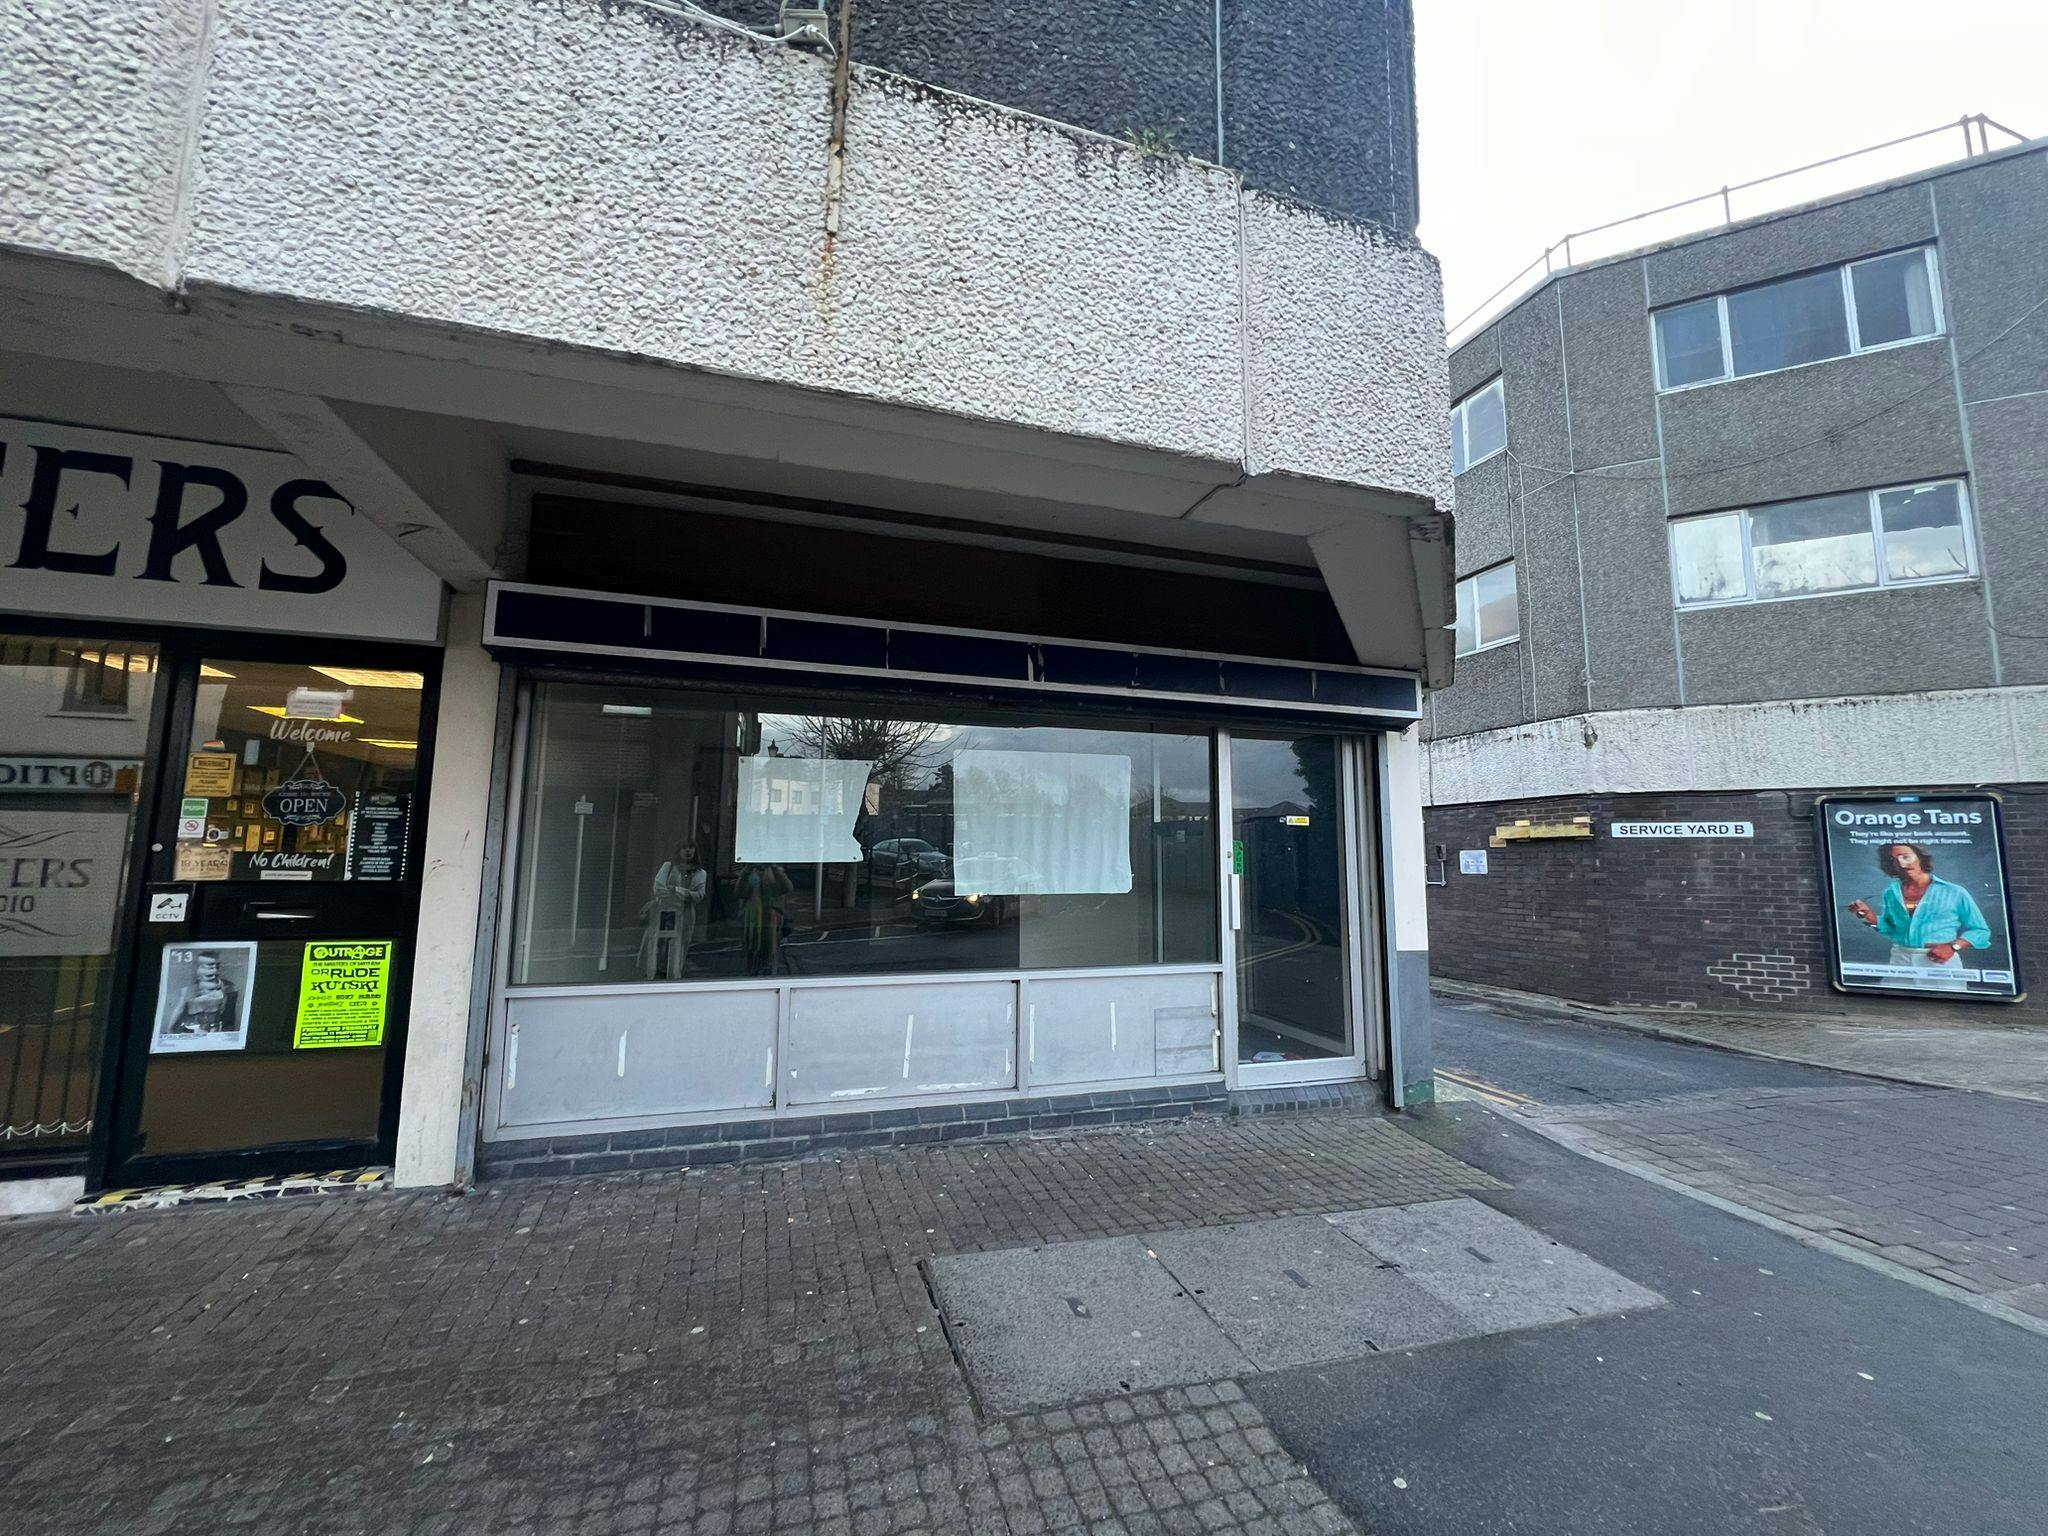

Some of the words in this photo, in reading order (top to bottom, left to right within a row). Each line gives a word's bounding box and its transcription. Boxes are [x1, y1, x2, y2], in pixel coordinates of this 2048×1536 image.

[0, 444, 355, 594] ERS
[270, 720, 351, 743] Welcome
[279, 798, 330, 813] OPEN
[1835, 810, 1921, 828] Orange
[1923, 809, 1982, 825] Tans
[1619, 825, 1683, 835] SERVICE
[1687, 824, 1729, 835] YARD
[1735, 824, 1745, 834] B
[1850, 830, 1879, 838] They're
[1849, 838, 1868, 846] They
[249, 853, 268, 869] No
[271, 853, 335, 869] Children!
[313, 945, 384, 960] OUTRAGE
[330, 967, 381, 978] RUDE
[310, 980, 380, 993] KUTSKI
